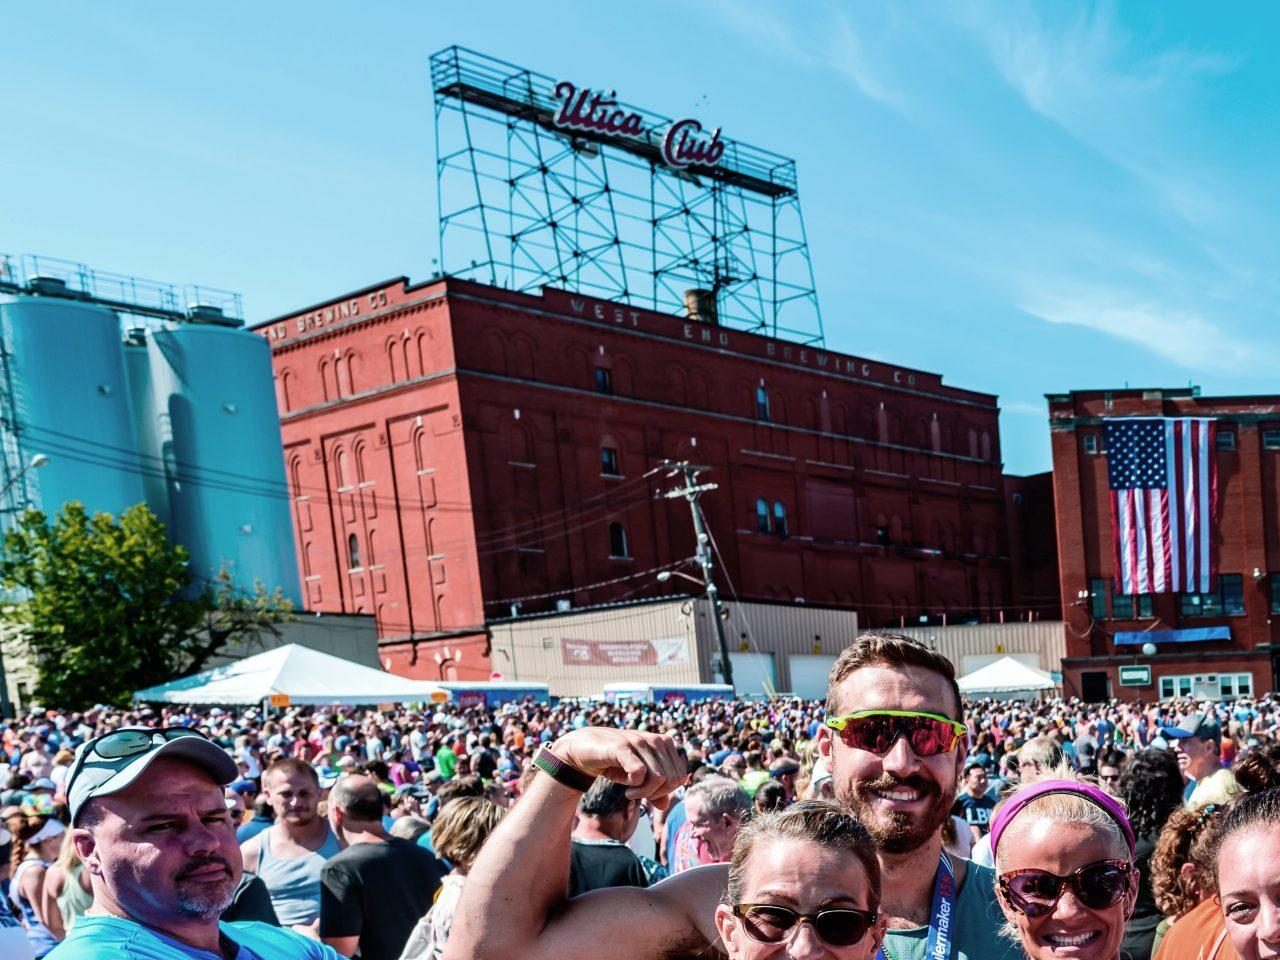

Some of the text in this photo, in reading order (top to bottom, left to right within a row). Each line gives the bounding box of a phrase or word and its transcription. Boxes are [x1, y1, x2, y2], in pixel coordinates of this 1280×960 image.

[554, 81, 725, 167] Utica Club
[297, 300, 360, 333] BREWING
[571, 299, 640, 326] WEST
[684, 324, 728, 346] END
[767, 342, 870, 377] BREWING
